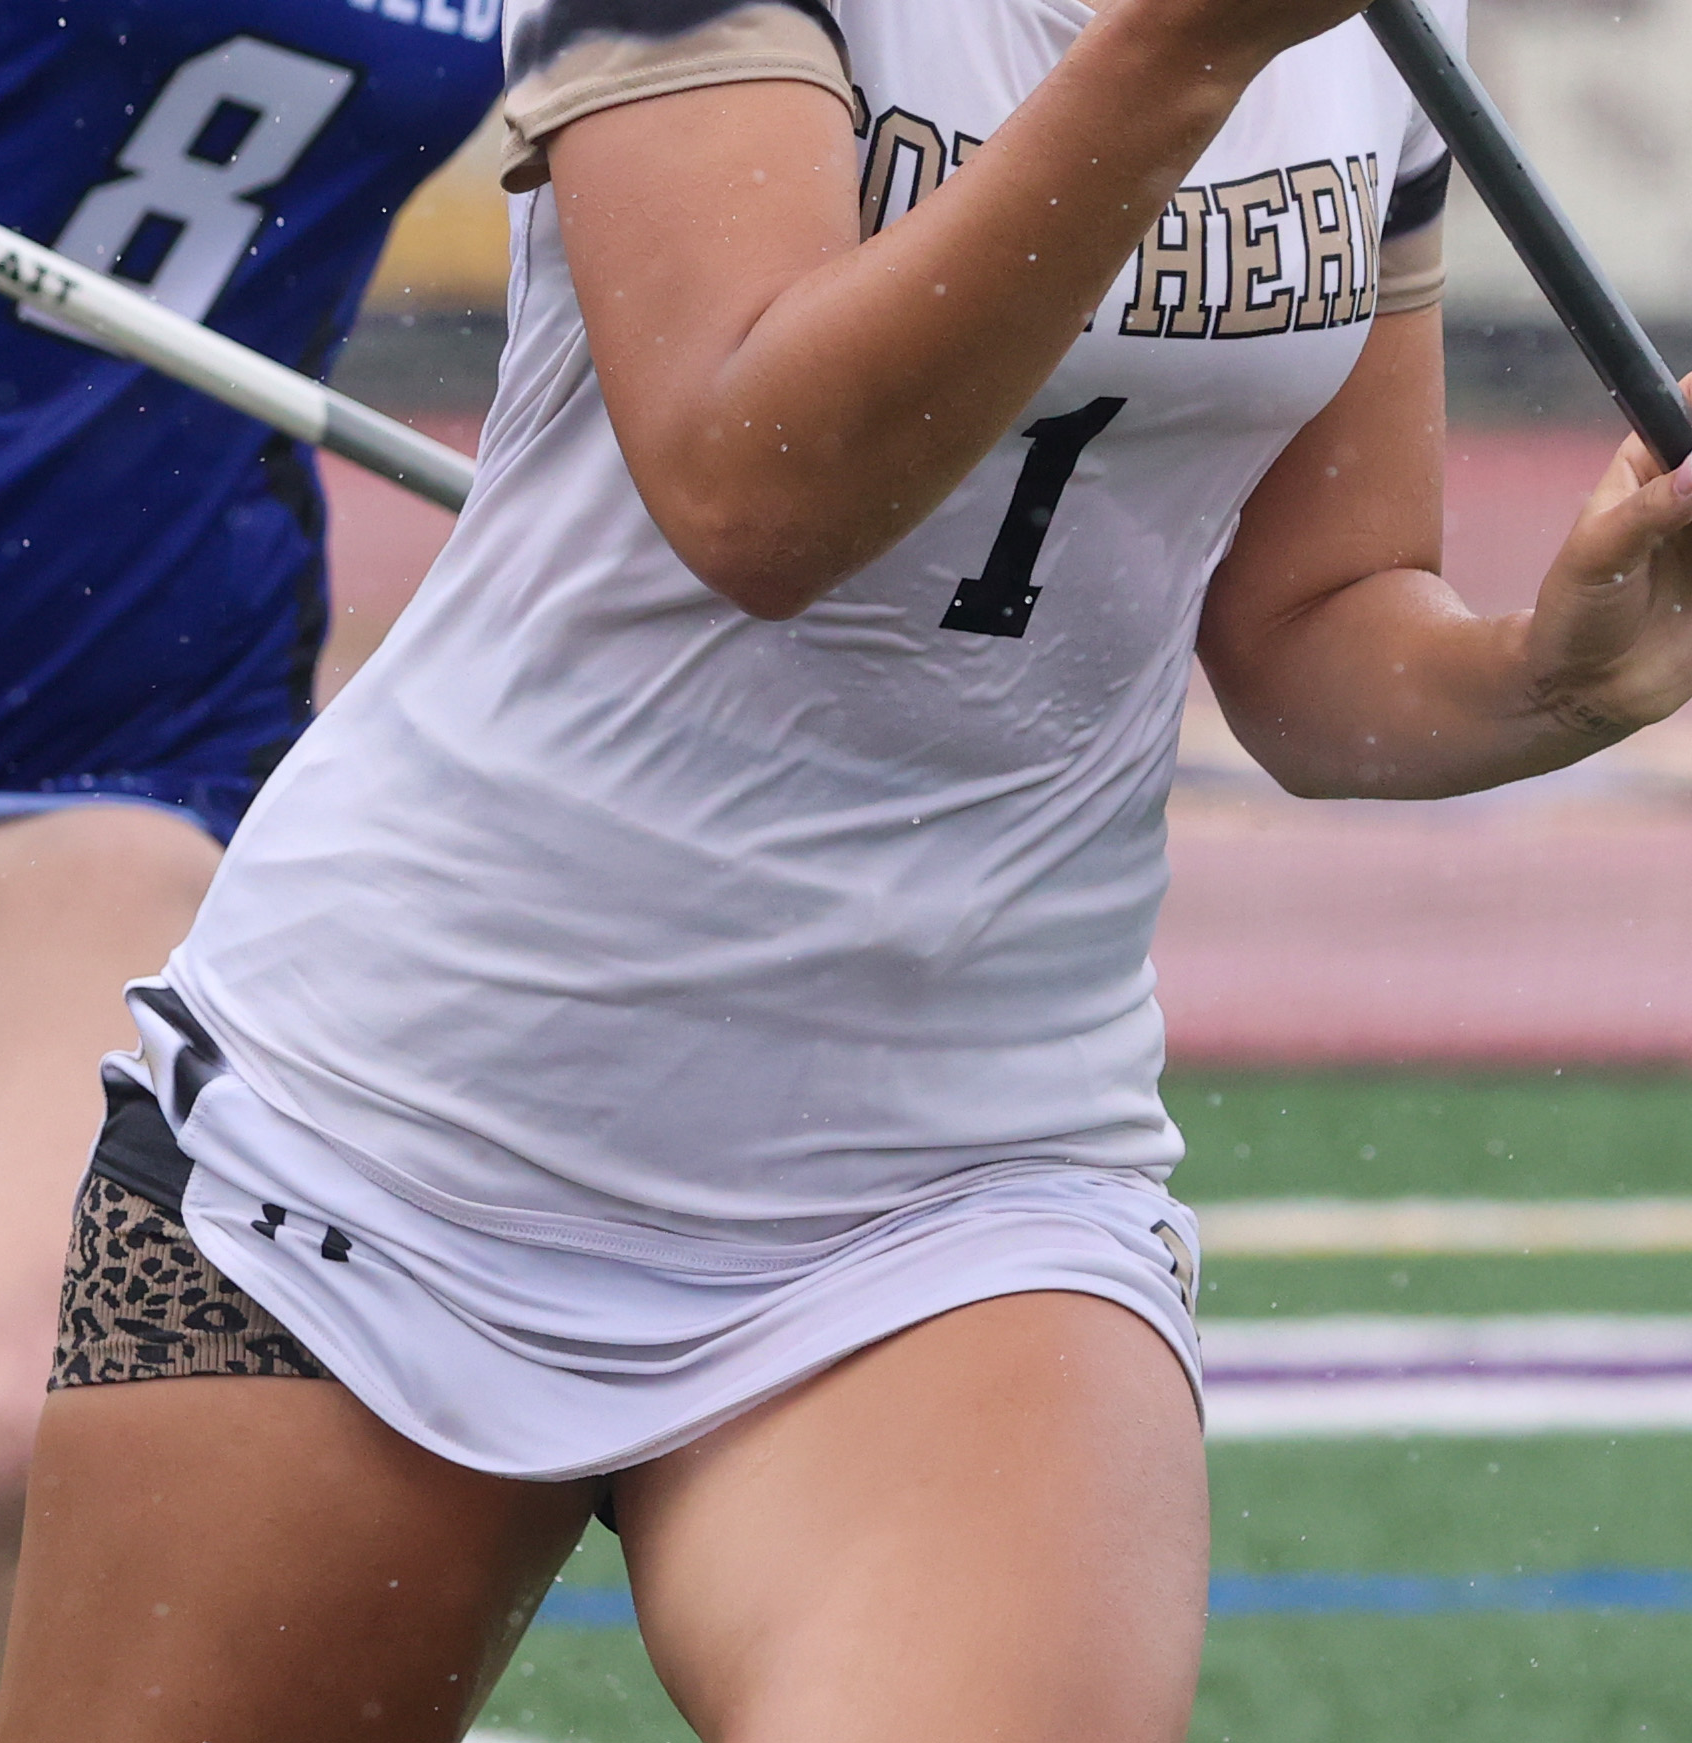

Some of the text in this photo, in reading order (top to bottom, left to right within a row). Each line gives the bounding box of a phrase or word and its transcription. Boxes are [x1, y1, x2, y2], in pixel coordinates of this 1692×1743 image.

[16, 33, 358, 360] 8
[851, 82, 1378, 340] OHERN
[939, 396, 1127, 639] 1
